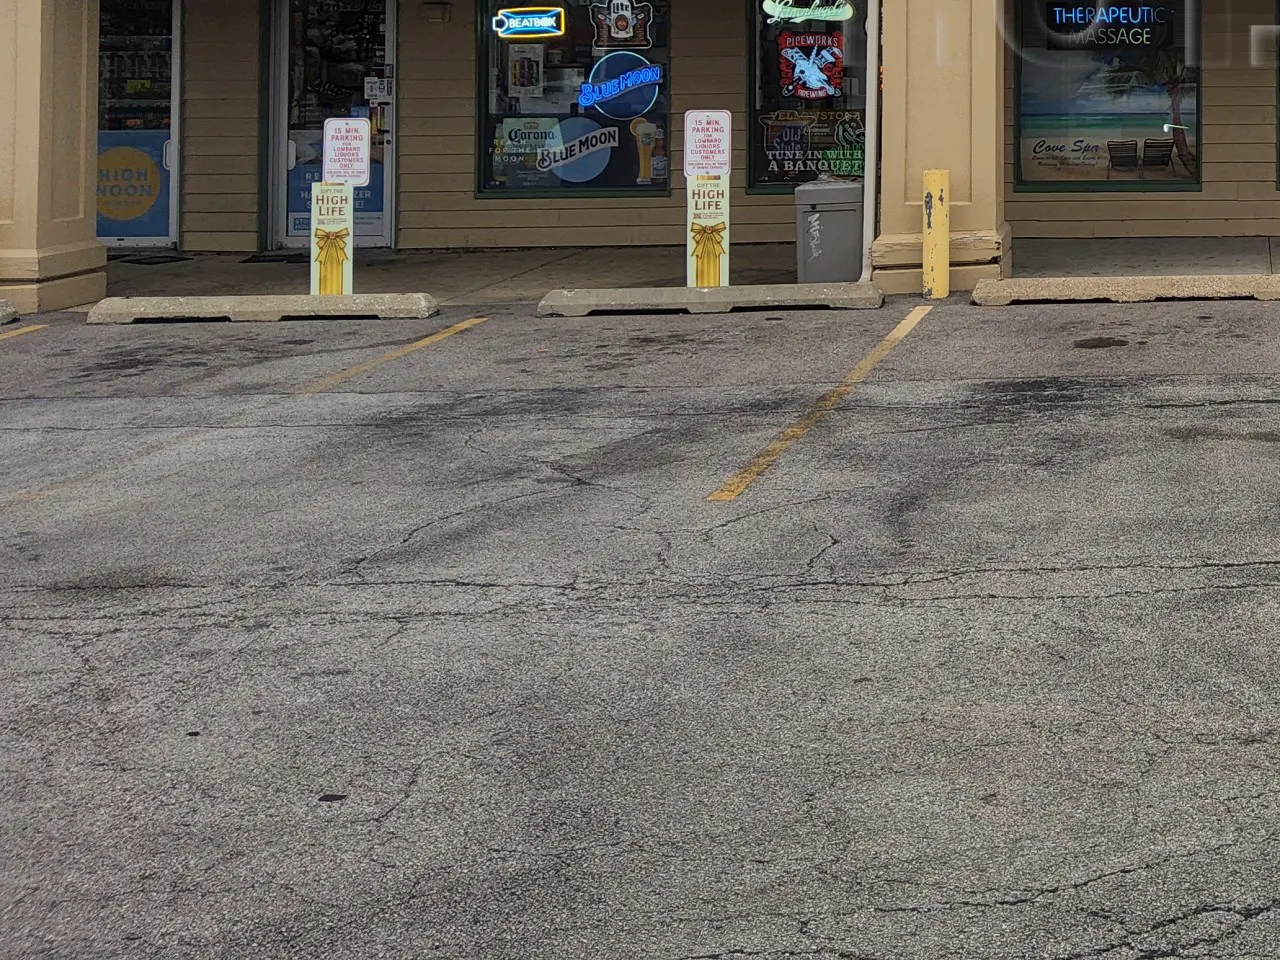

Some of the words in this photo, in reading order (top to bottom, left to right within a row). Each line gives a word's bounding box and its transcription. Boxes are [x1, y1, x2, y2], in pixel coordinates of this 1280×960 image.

[612, 3, 630, 13] Lite
[1053, 7, 1166, 24] THERAPEUTIC
[509, 16, 556, 28] BEATBOX
[786, 35, 839, 47] PIPEWORKS
[1068, 28, 1151, 45] MASSAGE
[578, 79, 620, 107] BLUE
[619, 66, 661, 91] MOON
[508, 128, 555, 141] Corona
[537, 143, 578, 170] BLUE
[578, 129, 618, 153] MOON
[1032, 139, 1067, 154] Cove
[1071, 139, 1101, 155] Spa
[767, 150, 804, 160] TUNE
[806, 150, 822, 160] IN
[825, 150, 864, 160] WITH
[768, 161, 779, 171] A
[99, 168, 148, 181] HIGH
[96, 185, 152, 197] NOON
[692, 189, 724, 200] HIGH
[315, 195, 348, 205] HIGH
[694, 200, 722, 210] LIFE
[318, 206, 345, 217] LIFE
